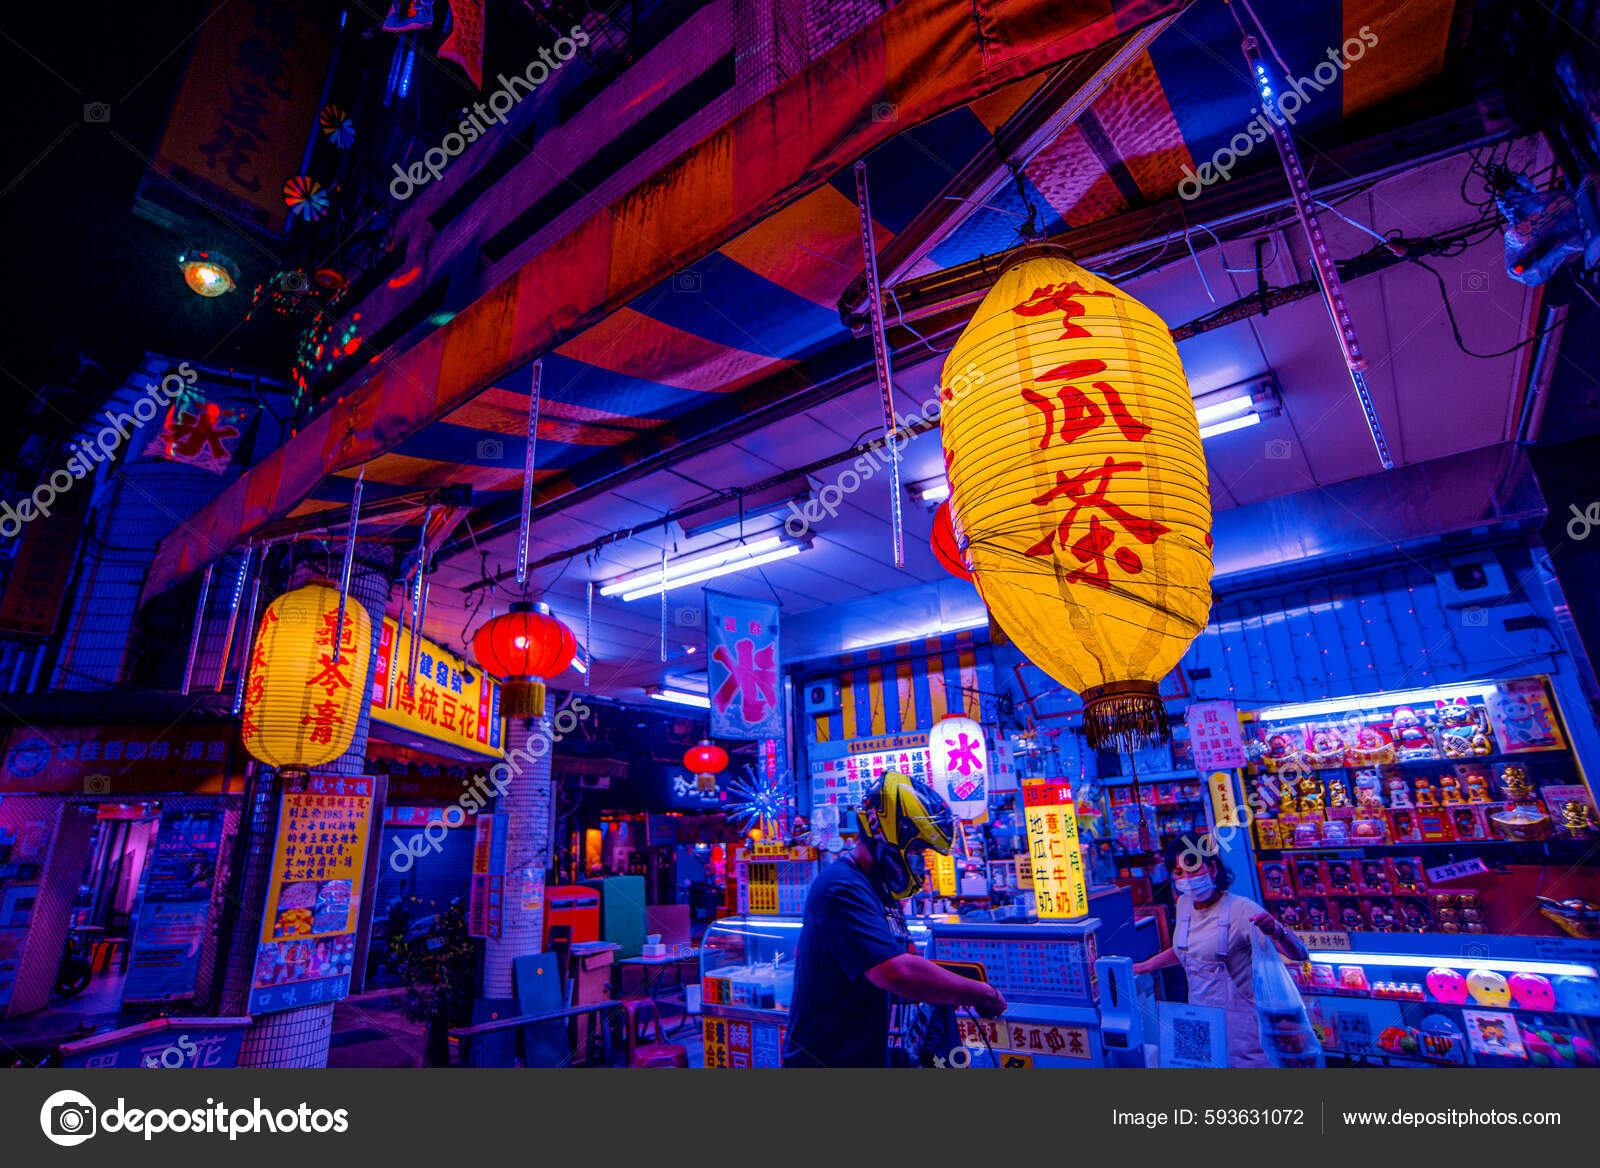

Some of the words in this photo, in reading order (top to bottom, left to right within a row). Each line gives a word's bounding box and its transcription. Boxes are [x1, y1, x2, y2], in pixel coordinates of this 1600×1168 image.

[396, 669, 476, 740] 傳統豆花
[1013, 1027, 1084, 1054] 冬瓜奶茶
